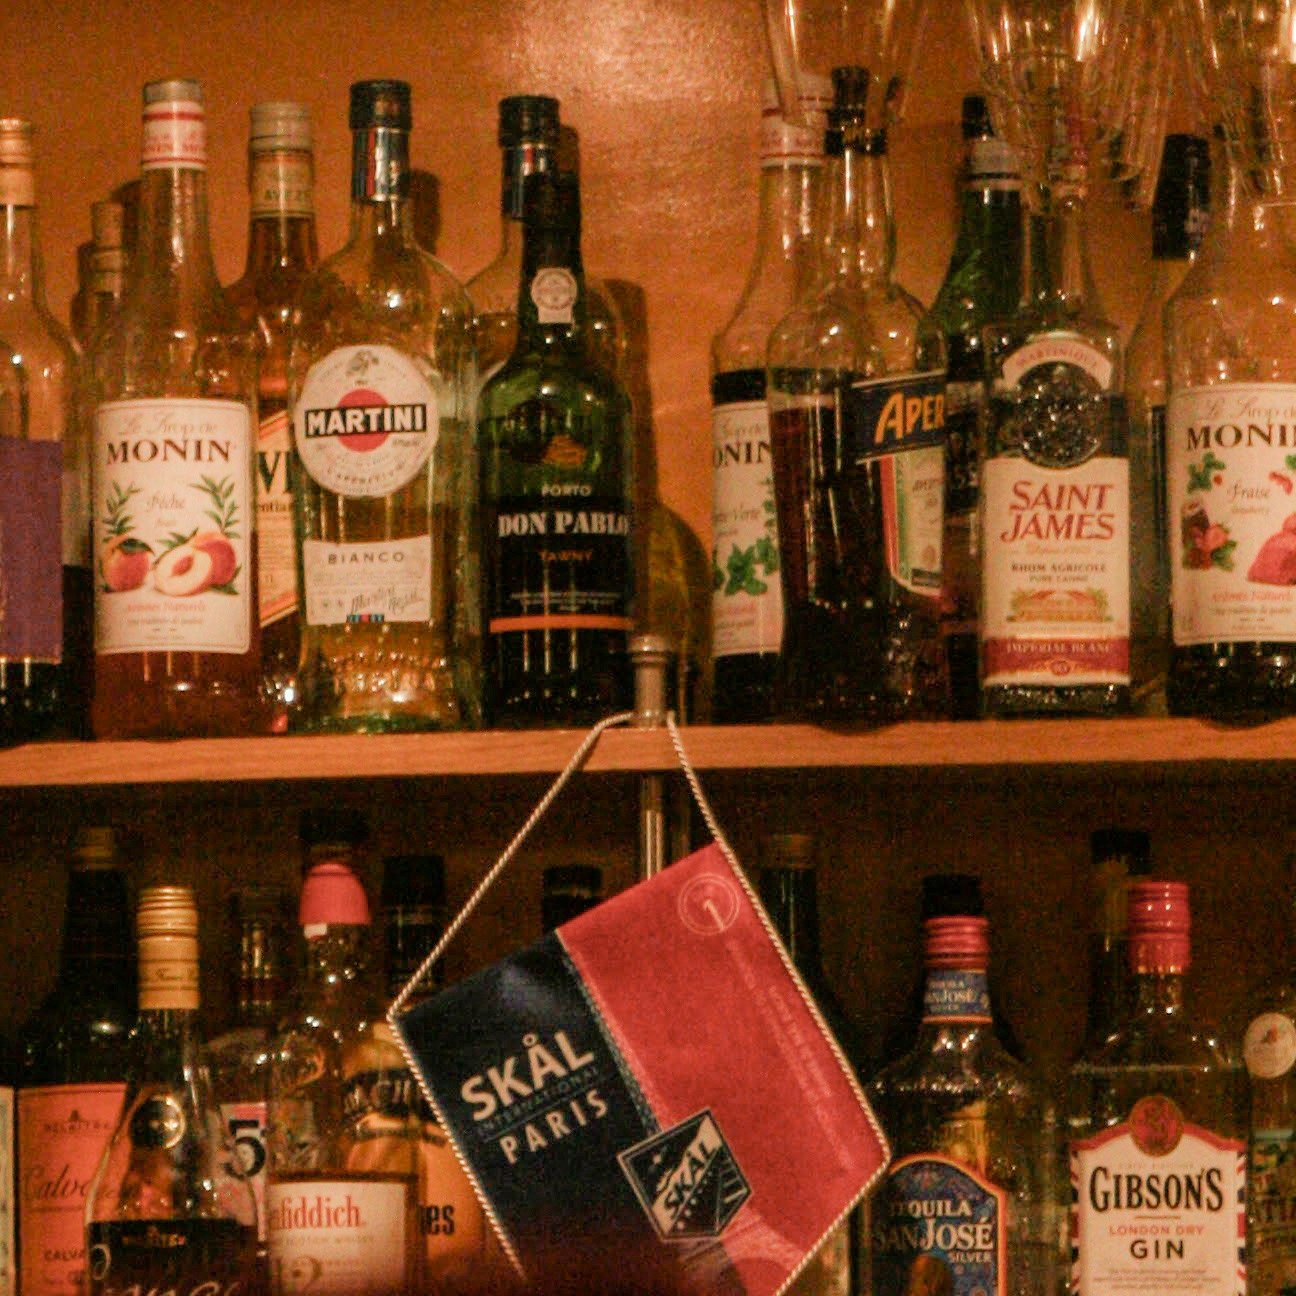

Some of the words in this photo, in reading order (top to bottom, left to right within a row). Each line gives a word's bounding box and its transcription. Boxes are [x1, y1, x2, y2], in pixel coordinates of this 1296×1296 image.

[308, 406, 425, 435] MARTINI
[874, 392, 944, 445] APER
[106, 438, 232, 465] MONIN
[1187, 423, 1296, 452] MONI
[713, 440, 772, 468] ONIN
[541, 484, 593, 497] PORTO
[1008, 480, 1115, 511] SAINT
[497, 511, 547, 538] DON
[554, 510, 630, 537] PABLO
[1000, 512, 1115, 543] JAMES
[327, 552, 405, 566] BIANCO
[1050, 562, 1107, 574] AGRICOLE
[461, 1031, 595, 1122] SKÅL
[499, 1088, 608, 1165] PARIS
[1089, 1166, 1224, 1213] GIBSON'S
[270, 1194, 361, 1231] fiddich
[918, 1216, 995, 1251] JOSÉ
[1108, 1223, 1171, 1237] LONDON
[1175, 1223, 1205, 1236] DRY
[948, 1252, 993, 1264] SILVER
[1129, 1239, 1185, 1260] GIN
